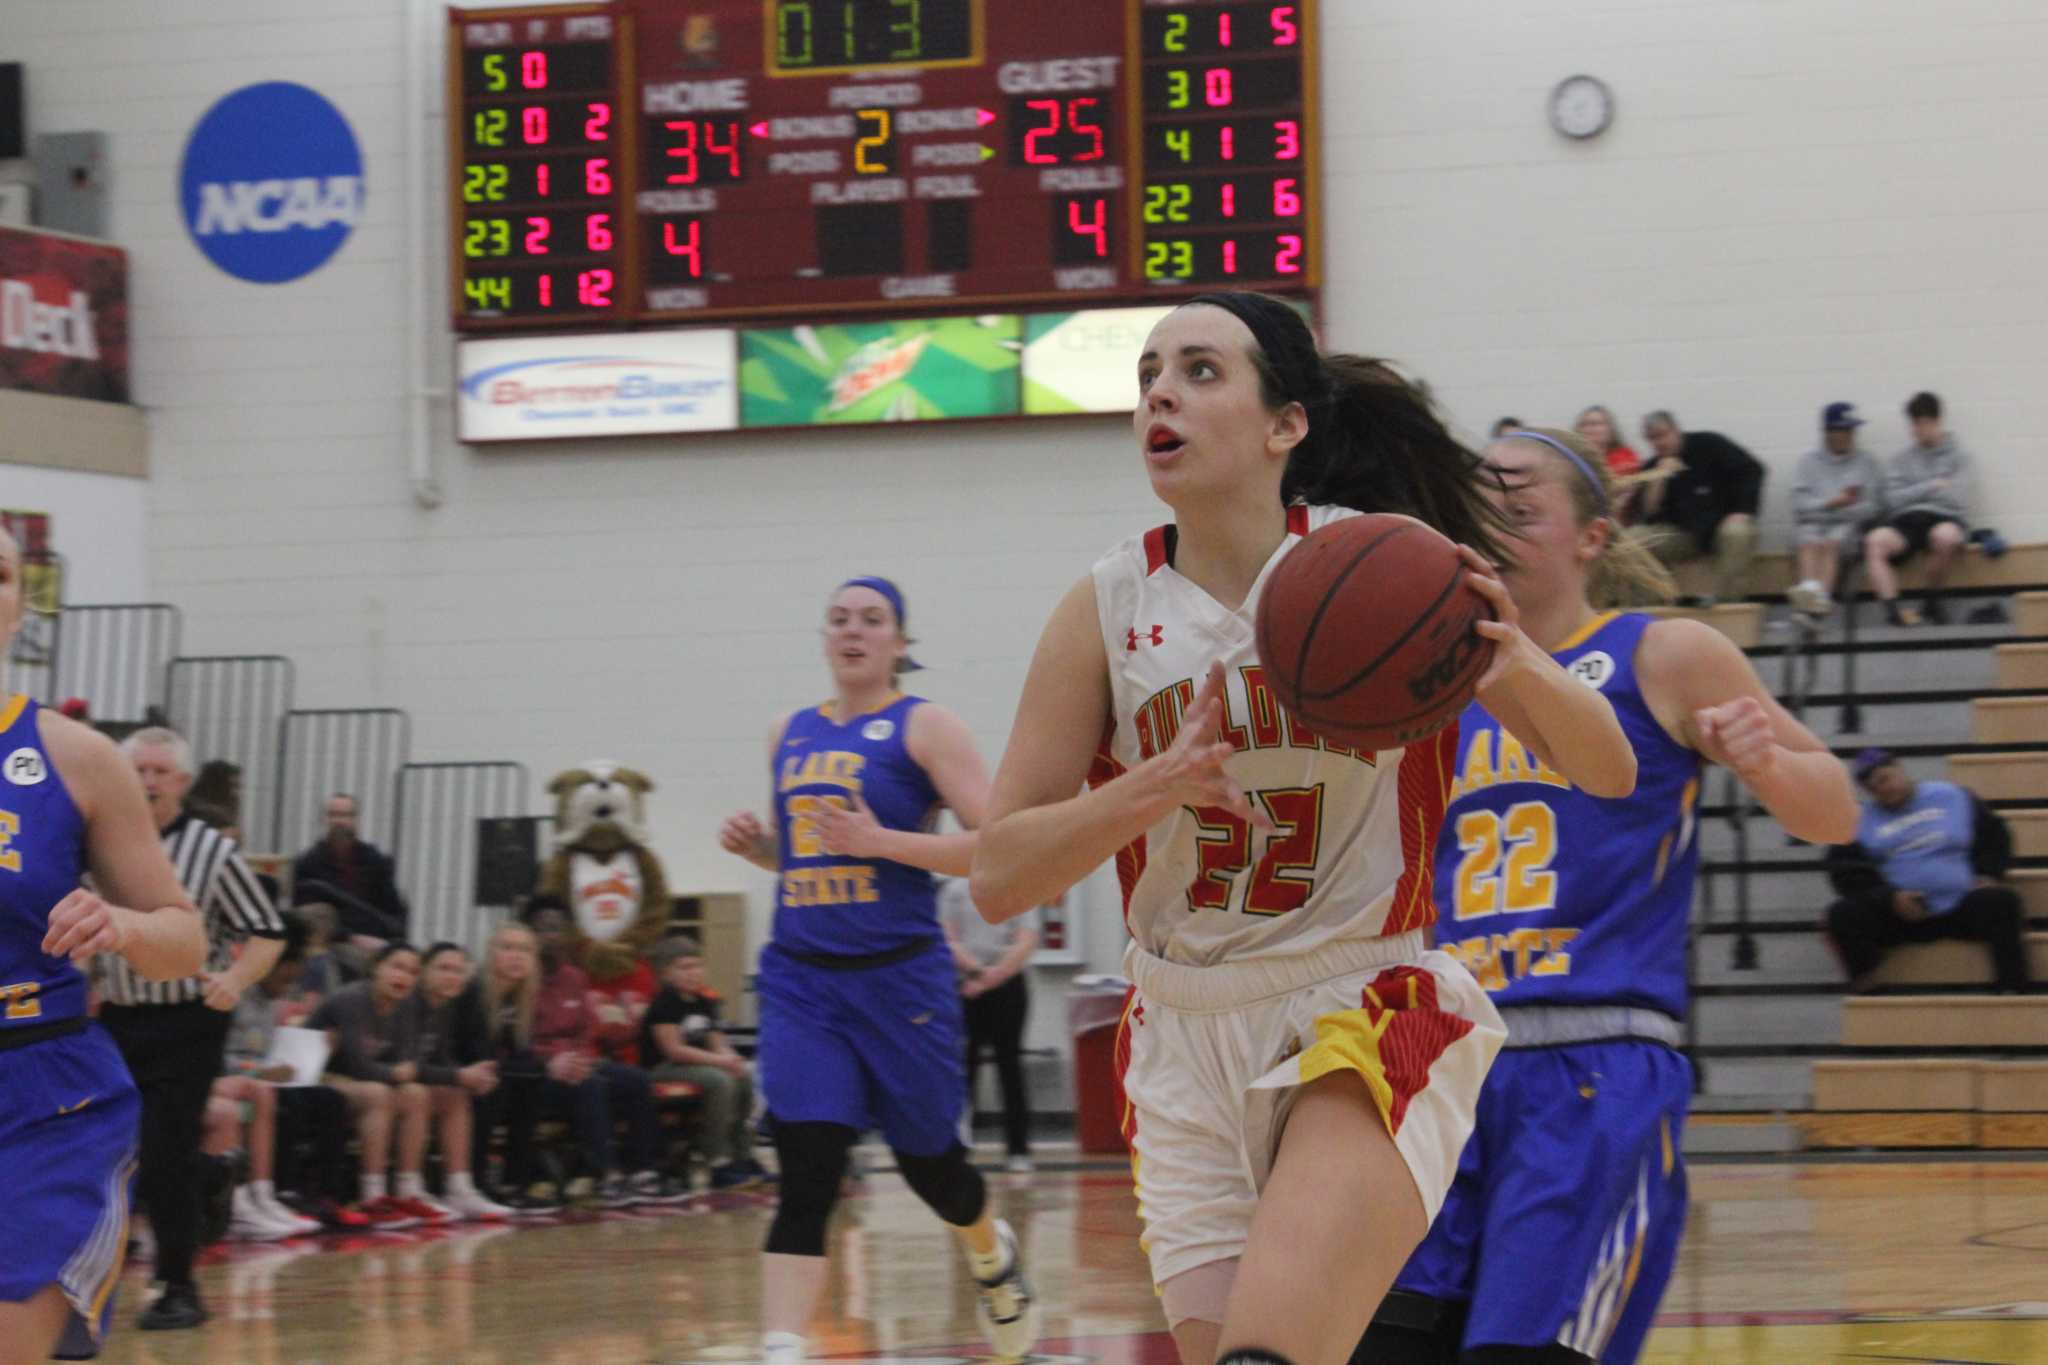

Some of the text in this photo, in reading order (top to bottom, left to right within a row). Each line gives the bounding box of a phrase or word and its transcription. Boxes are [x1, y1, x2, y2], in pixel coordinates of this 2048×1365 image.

[1164, 6, 1297, 52] 2 1 5
[483, 51, 547, 91] 5 0
[998, 56, 1120, 94] GUEST
[1168, 68, 1232, 109] 3 0
[644, 79, 747, 114] HOME
[829, 83, 921, 107] PERIOD
[475, 102, 611, 146] 12 0 2
[768, 115, 855, 140] BONUS
[855, 109, 889, 173] 2
[1024, 98, 1105, 164] 25
[1166, 121, 1298, 163] 4 1 3
[665, 121, 740, 184] 34
[463, 158, 612, 202] 22 1 6
[1144, 179, 1300, 223] 22 1 6
[196, 176, 363, 235] NCAA
[464, 214, 613, 257] 23 2 6
[664, 221, 700, 278] 4
[1069, 200, 1107, 257] 4
[1145, 235, 1301, 279] 23 1 2
[465, 269, 613, 309] 44 1 12
[778, 751, 866, 792] LAKE
[1186, 783, 1324, 918] 22
[1452, 800, 1558, 921] 22
[783, 866, 881, 907] STATE
